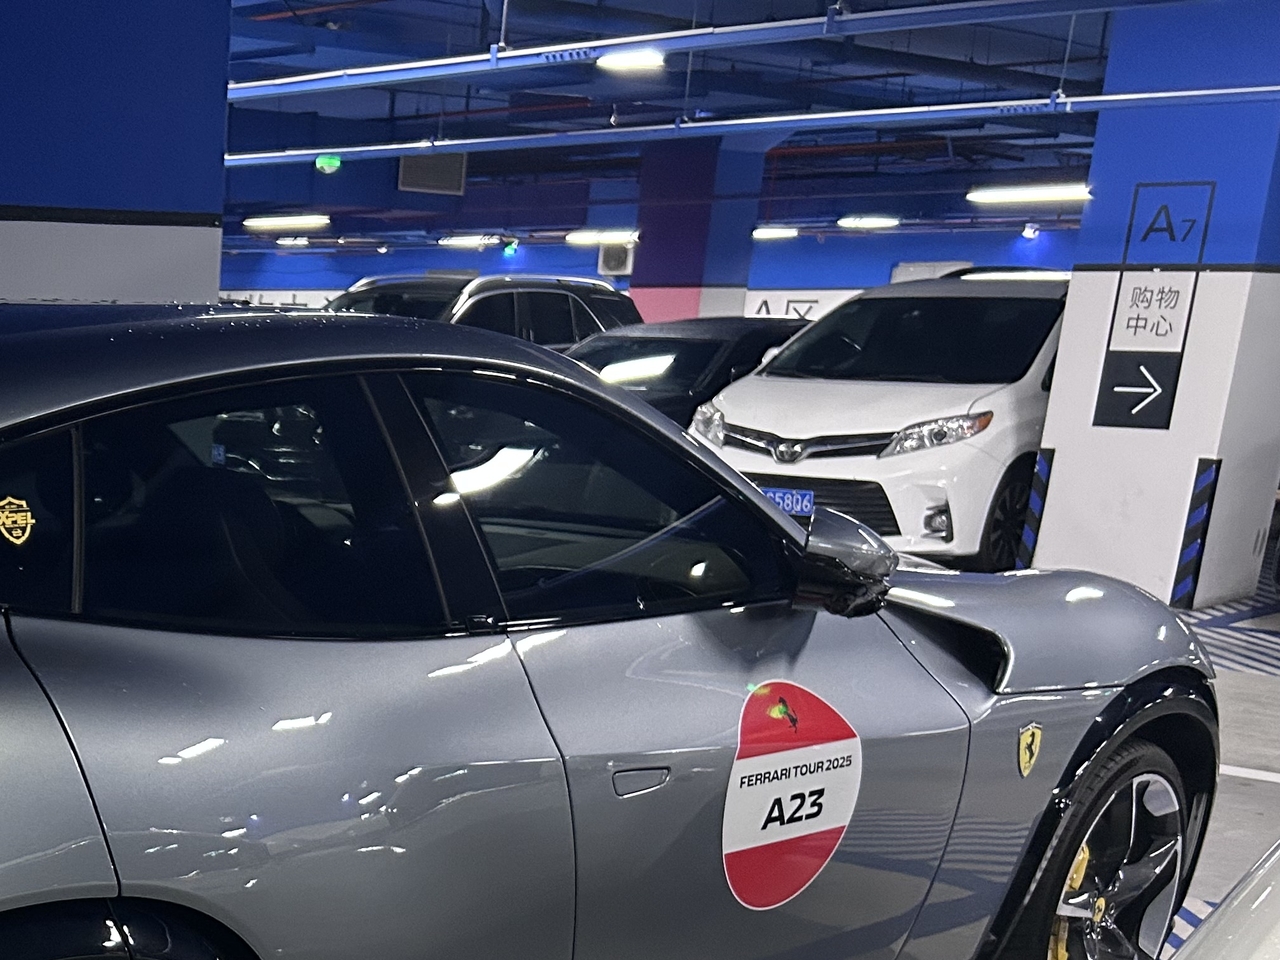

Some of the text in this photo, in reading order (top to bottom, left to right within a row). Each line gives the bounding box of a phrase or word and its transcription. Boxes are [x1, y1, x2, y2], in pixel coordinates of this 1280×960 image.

[1140, 204, 1197, 242] A7
[1129, 286, 1180, 309] 购物
[1126, 314, 1173, 336] 中心
[739, 755, 852, 788] FERRARI TOUR 2025
[760, 787, 825, 831] A23
